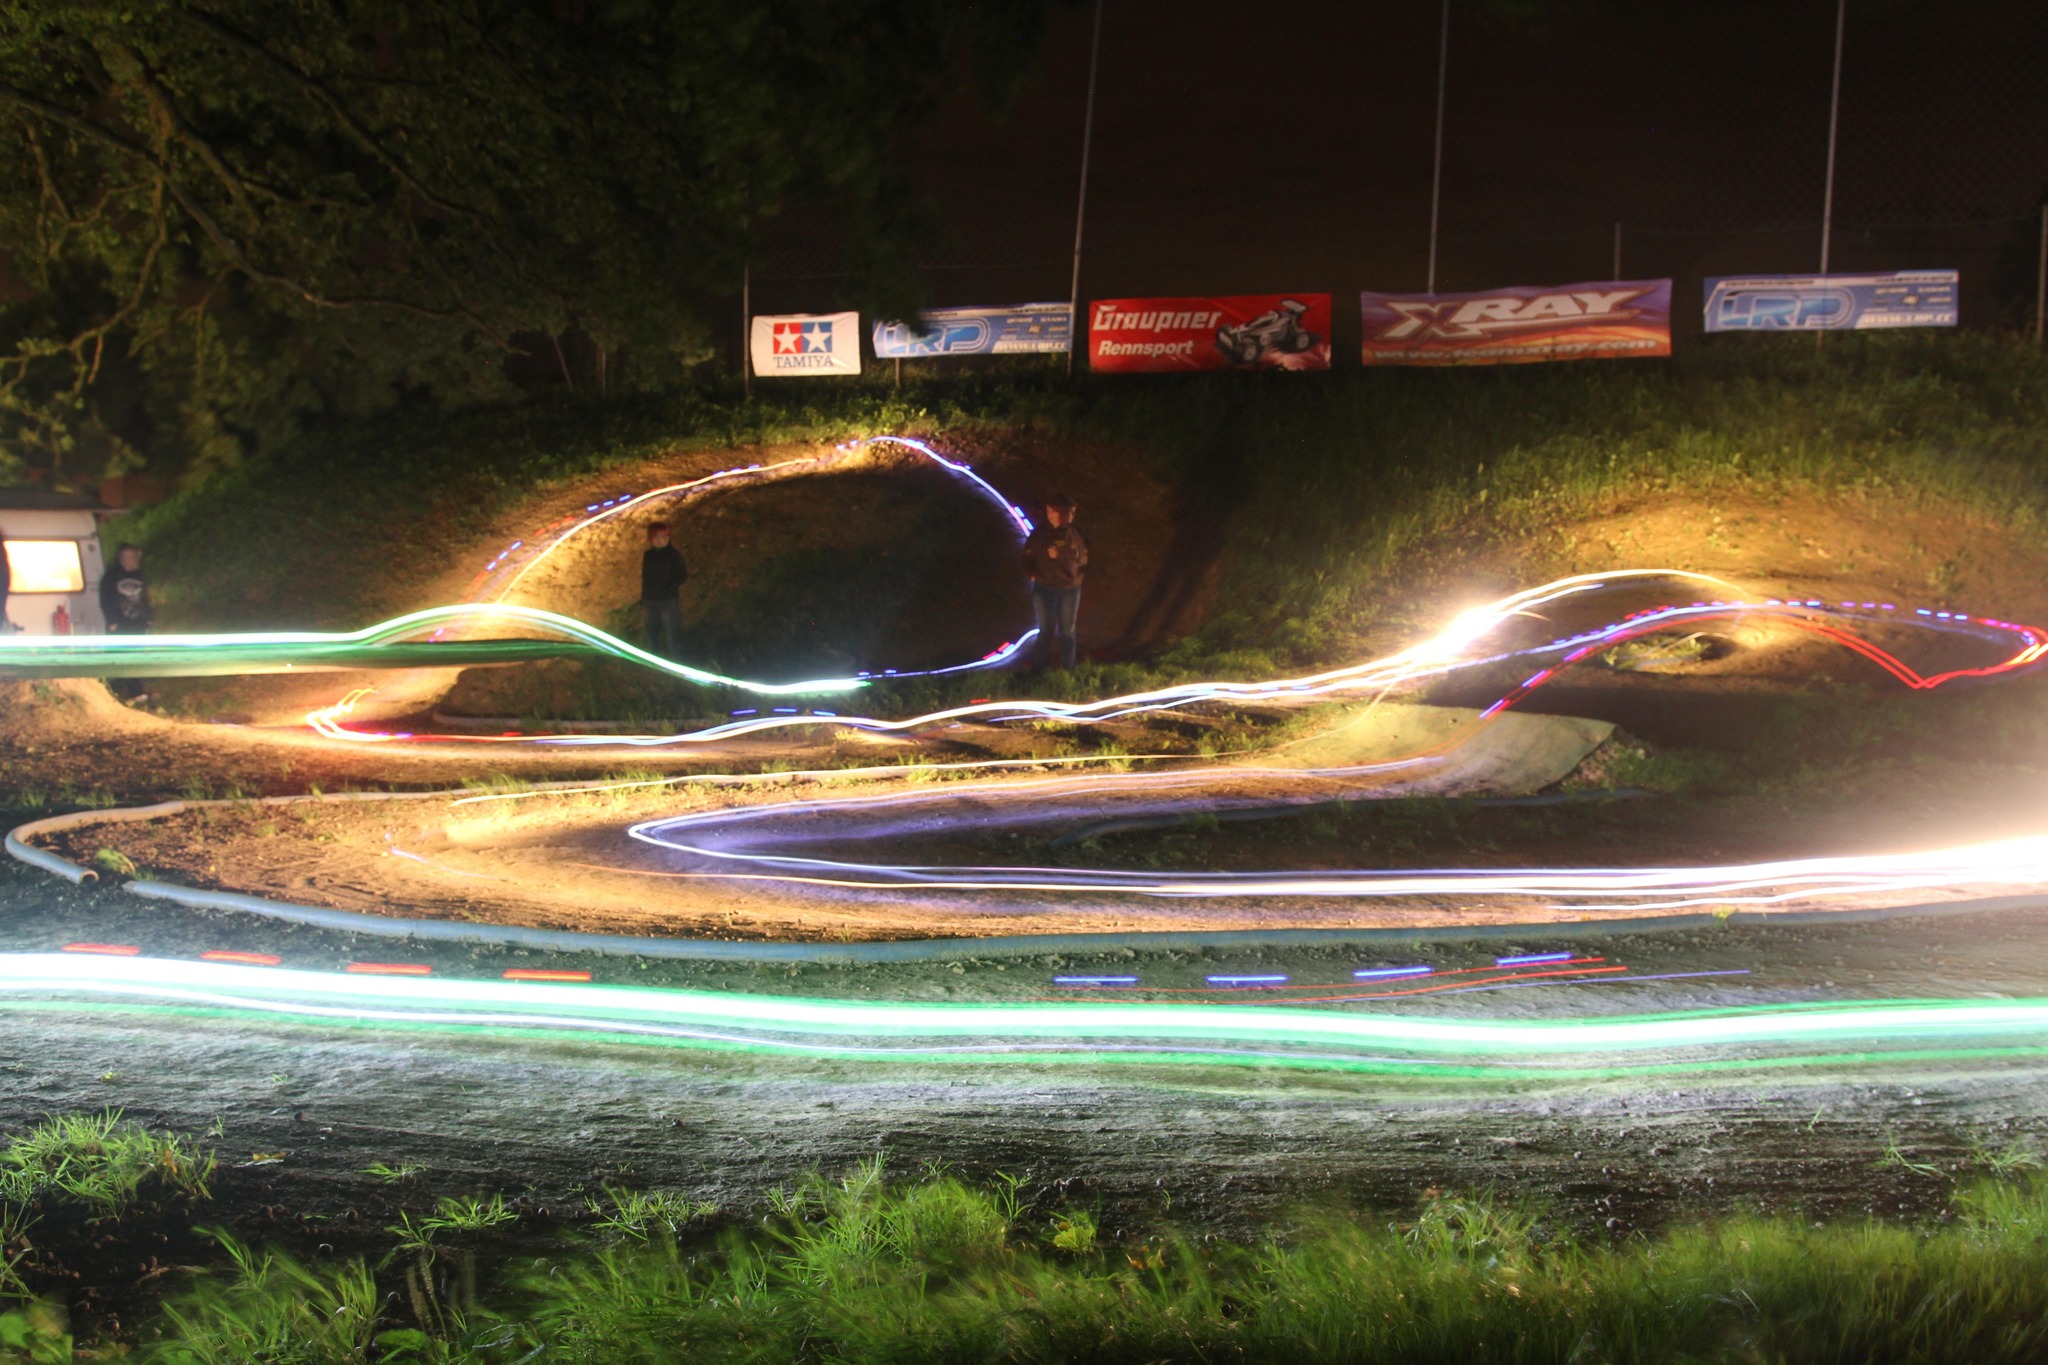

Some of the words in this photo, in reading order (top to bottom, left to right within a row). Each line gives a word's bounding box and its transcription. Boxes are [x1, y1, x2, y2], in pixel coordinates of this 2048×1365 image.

[1093, 305, 1223, 332] Graupner
[1376, 287, 1656, 340] XRAY
[1719, 289, 1854, 328] LRP
[773, 355, 834, 369] TAMIYA
[1098, 339, 1194, 358] Rennsport
